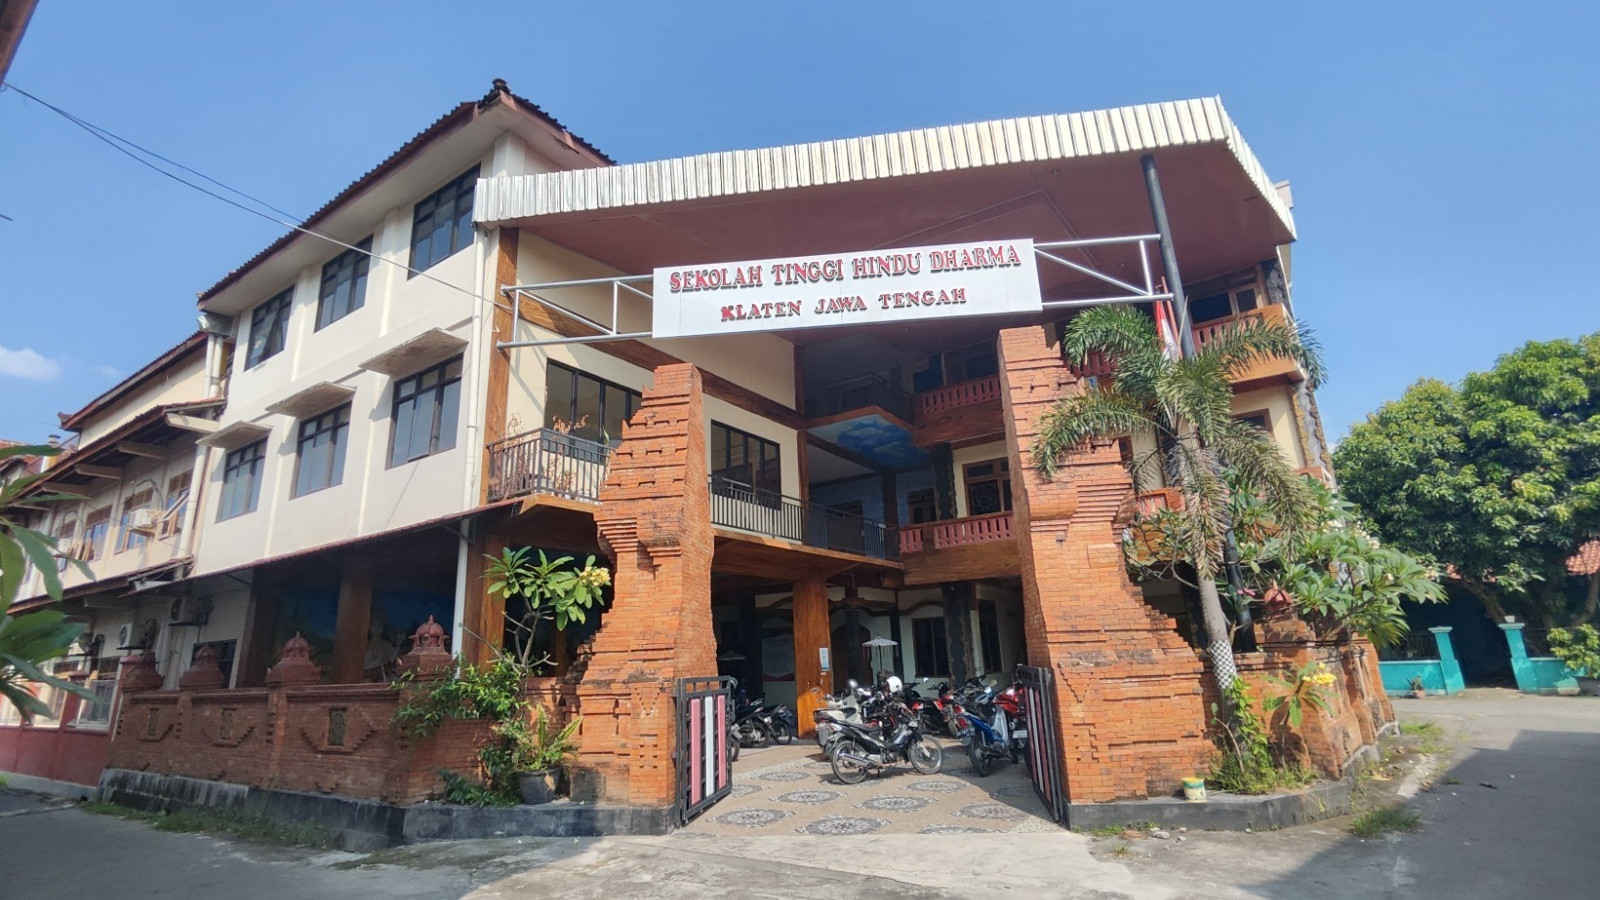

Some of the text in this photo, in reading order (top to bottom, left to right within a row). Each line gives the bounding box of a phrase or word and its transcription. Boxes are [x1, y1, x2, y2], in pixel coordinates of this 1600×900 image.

[669, 244, 1022, 293] SEKOLAH TINGGI HINDU DHARMA
[720, 288, 967, 322] KLATEN JAWA TENGAH
